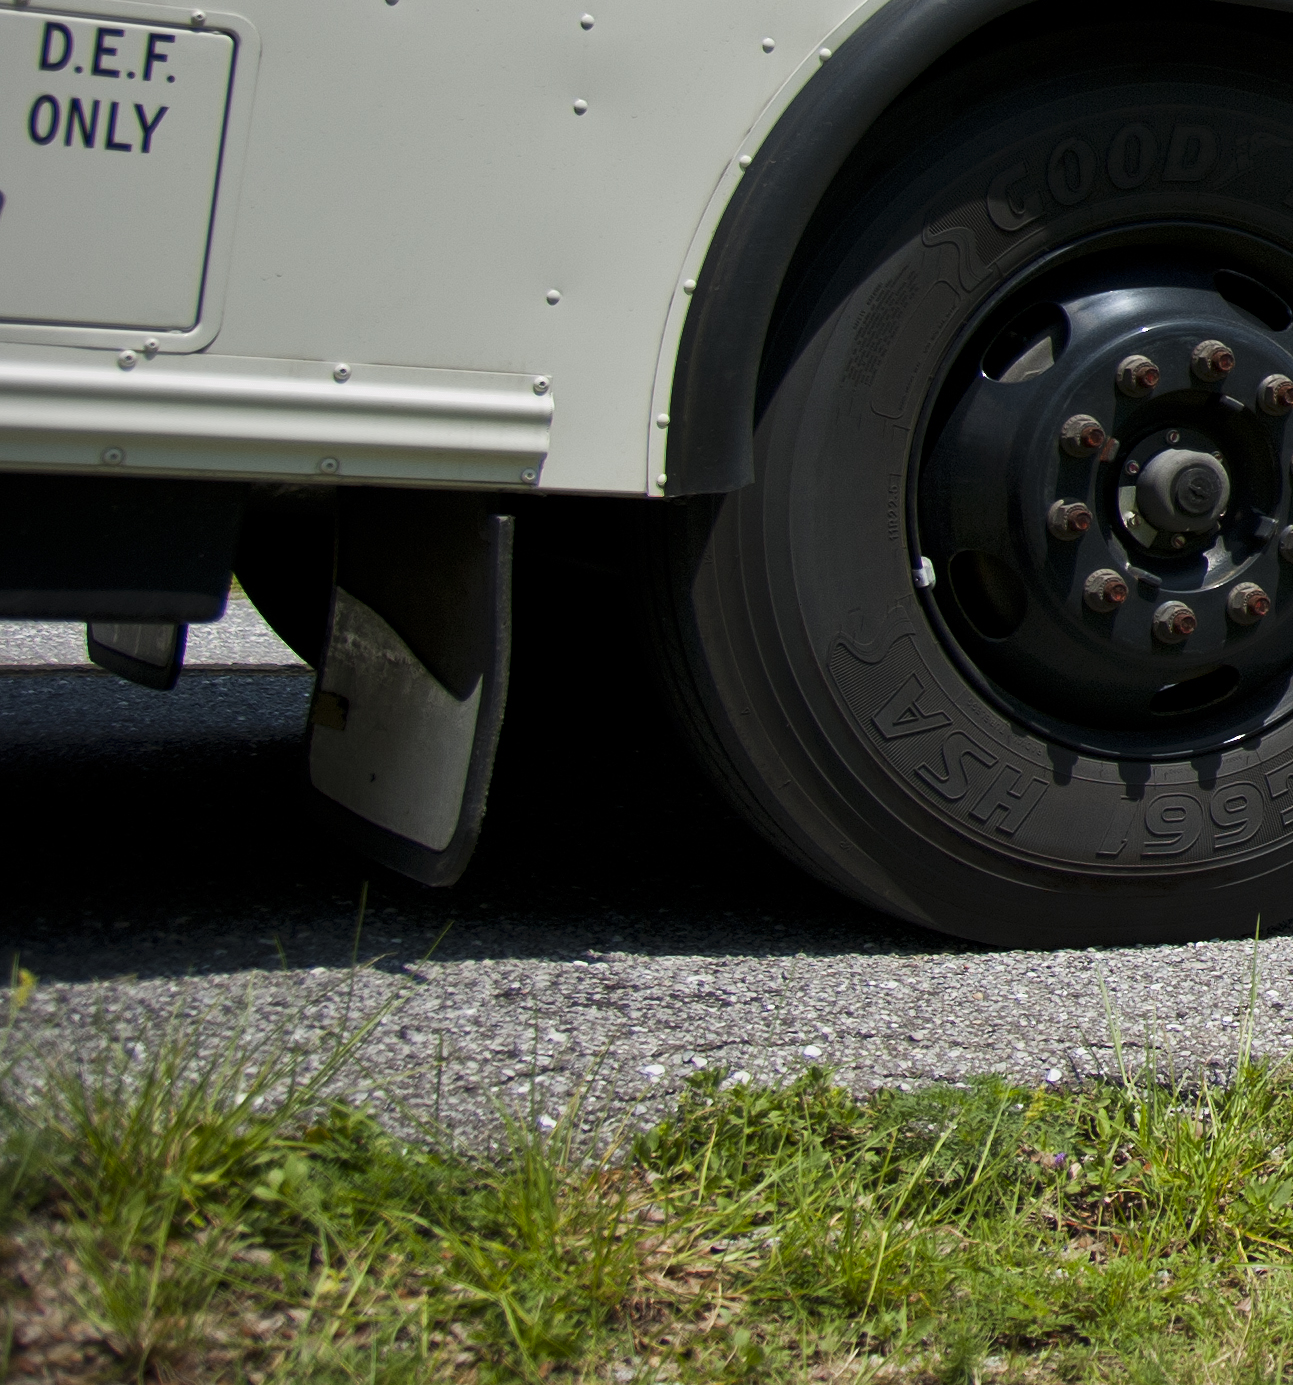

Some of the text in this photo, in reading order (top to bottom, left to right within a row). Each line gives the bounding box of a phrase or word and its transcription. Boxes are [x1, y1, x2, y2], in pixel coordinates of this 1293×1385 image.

[38, 21, 176, 84] D.E.F.
[27, 93, 170, 154] ONLY
[872, 672, 1050, 835] HSA
